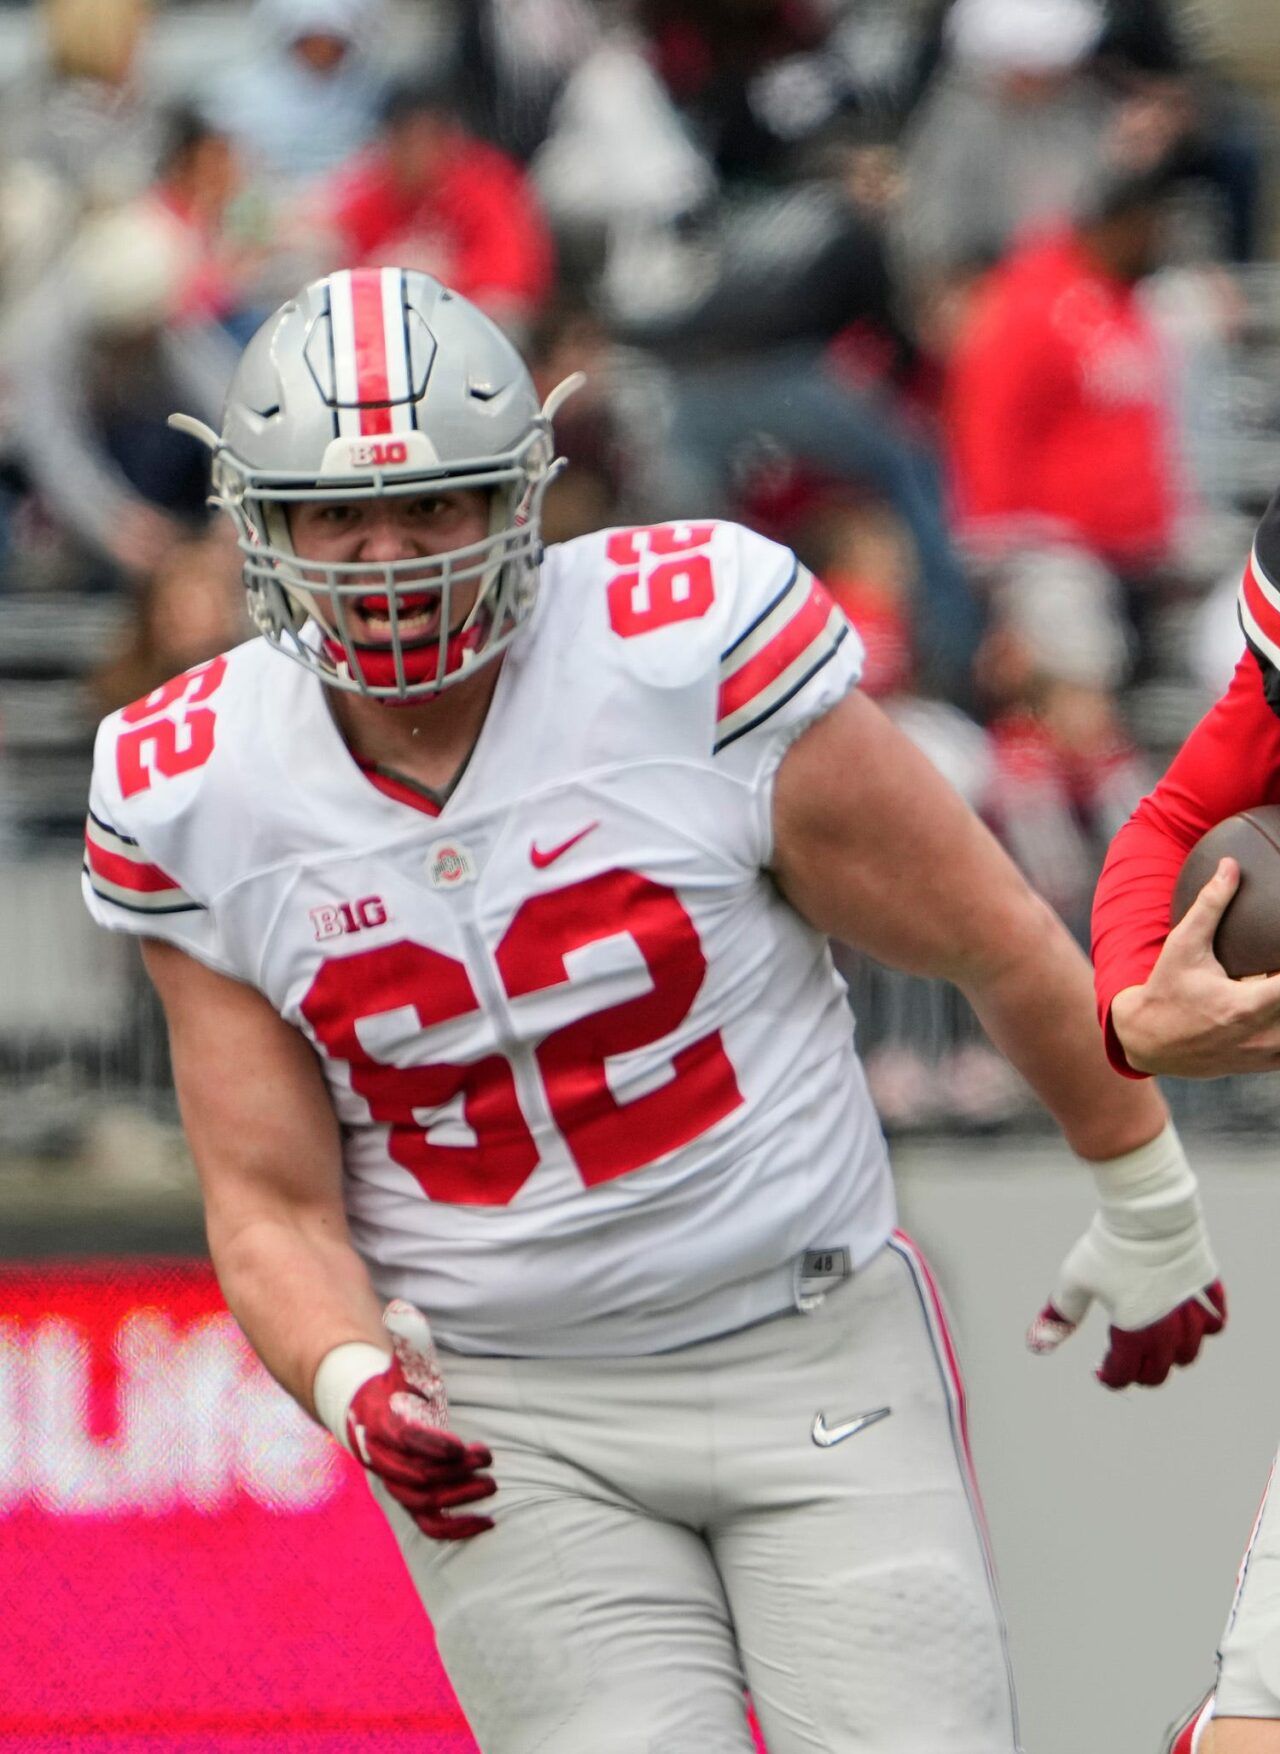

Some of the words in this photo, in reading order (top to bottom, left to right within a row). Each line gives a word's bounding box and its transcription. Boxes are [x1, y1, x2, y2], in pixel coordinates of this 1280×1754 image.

[605, 522, 717, 640] 62
[115, 655, 229, 799] 62
[299, 866, 747, 1207] 62
[813, 1253, 834, 1273] 48
